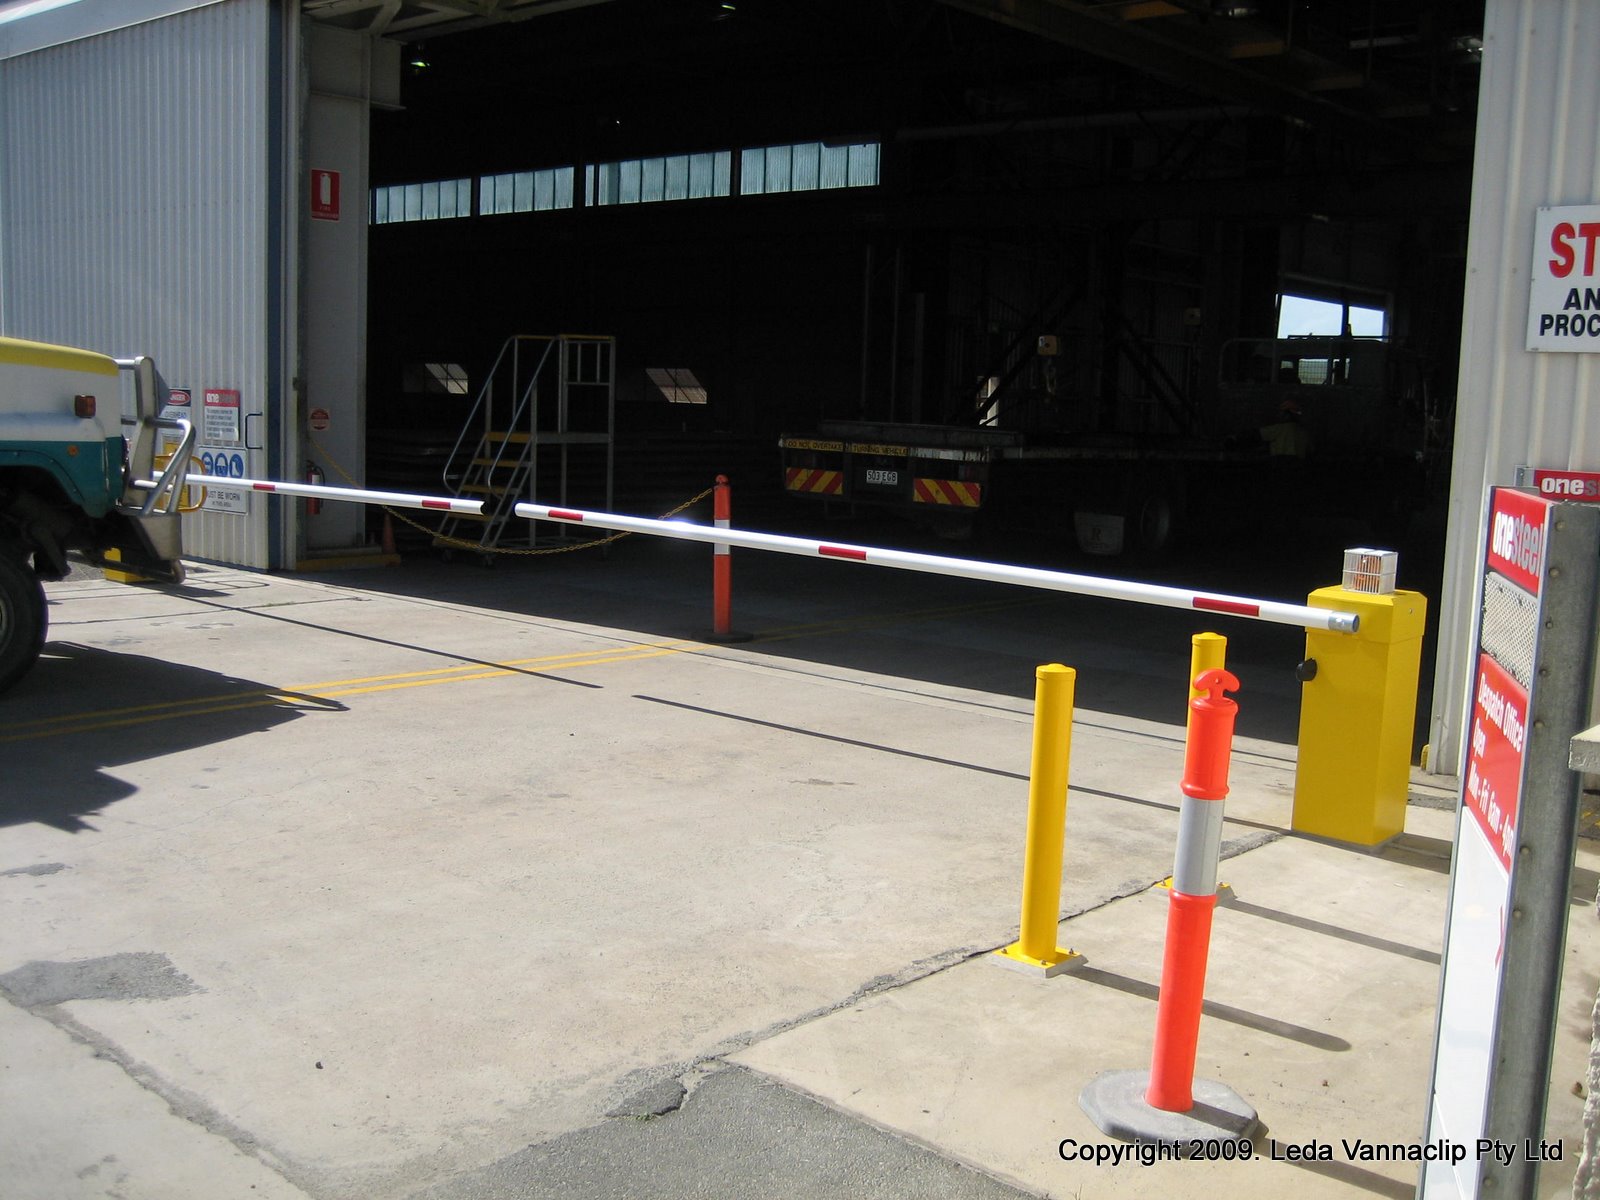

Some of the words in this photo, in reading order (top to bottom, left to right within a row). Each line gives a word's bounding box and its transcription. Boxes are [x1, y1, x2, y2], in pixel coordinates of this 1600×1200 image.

[1492, 511, 1544, 577] onesteel
[1472, 717, 1486, 759] Open
[1478, 672, 1504, 730] Despatch
[1503, 701, 1523, 753] Office
[1467, 760, 1479, 801] Mon
[1479, 778, 1490, 815] Fri
